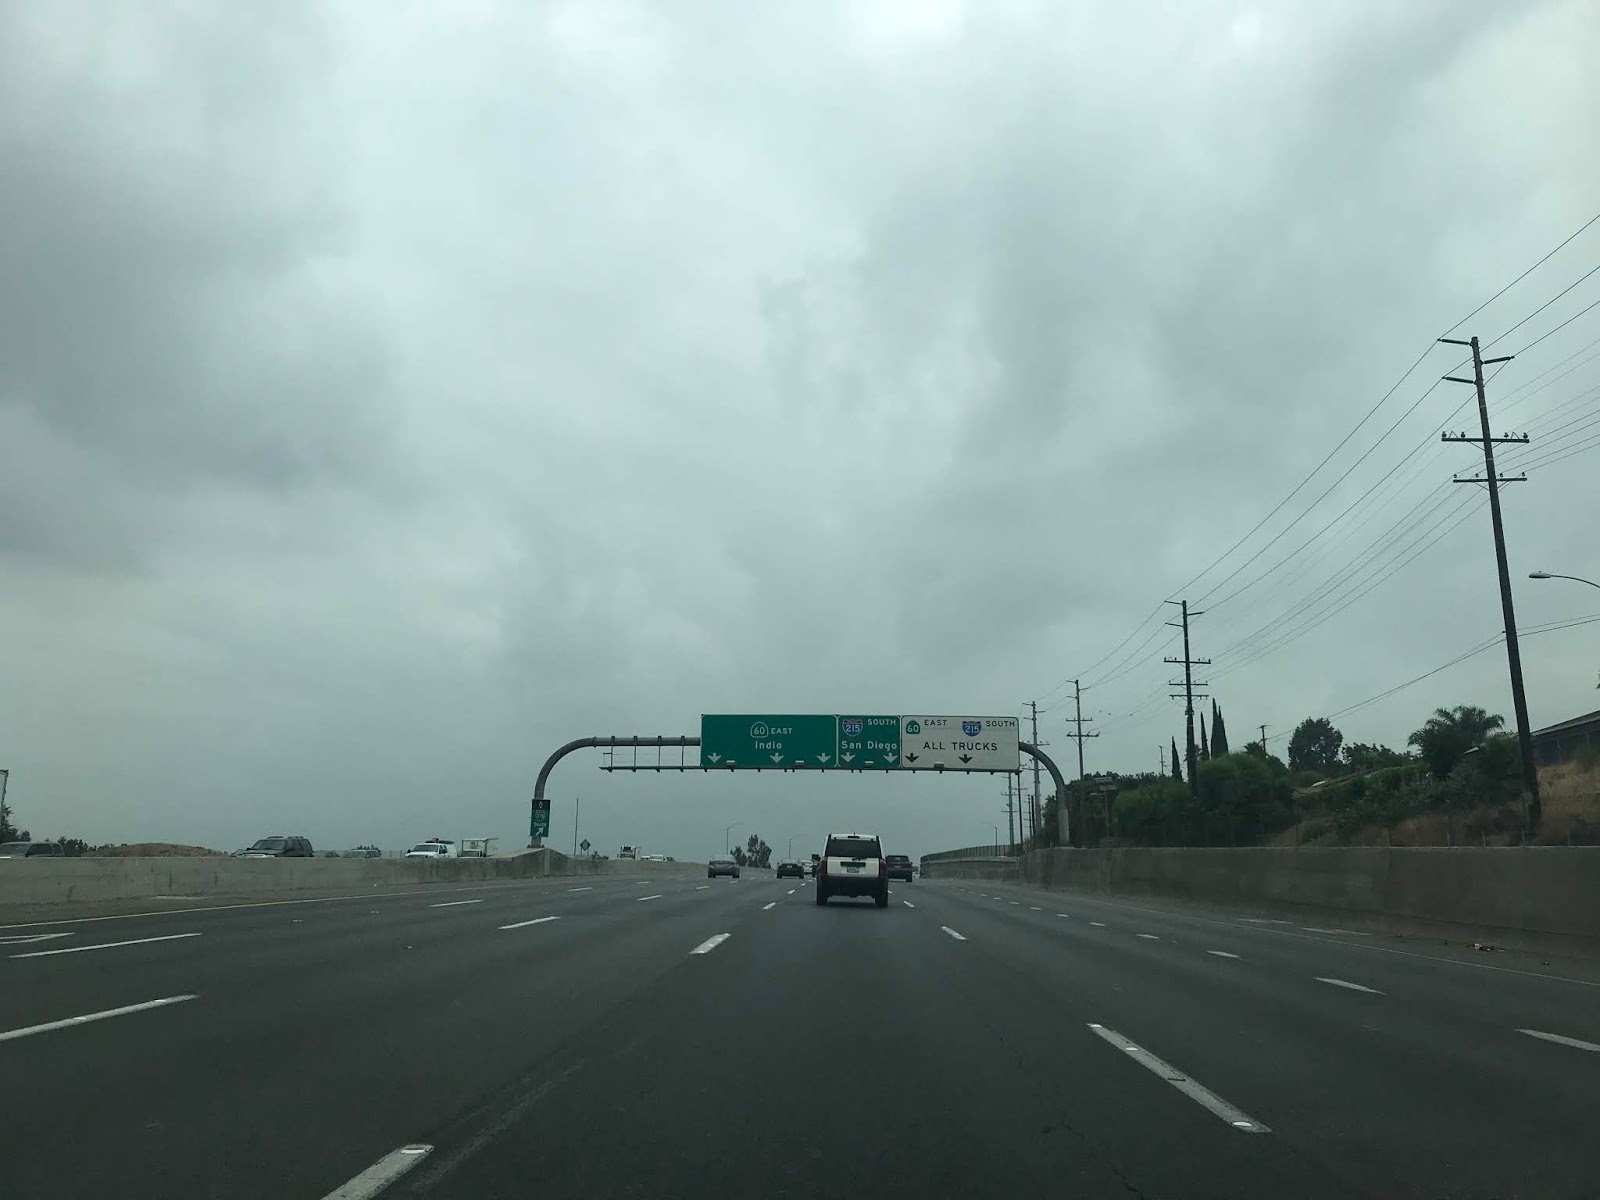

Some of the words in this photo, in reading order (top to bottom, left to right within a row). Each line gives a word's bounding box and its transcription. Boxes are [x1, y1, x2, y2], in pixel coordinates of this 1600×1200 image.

[845, 724, 861, 733] 215
[867, 718, 897, 726] SOUTH
[907, 724, 919, 733] 60
[965, 725, 980, 734] 215
[753, 726, 766, 735] 60
[755, 741, 782, 750] Indio
[841, 740, 862, 749] San
[867, 740, 897, 752] Diego
[923, 741, 946, 750] ALL
[952, 741, 998, 751] TRUCKS
